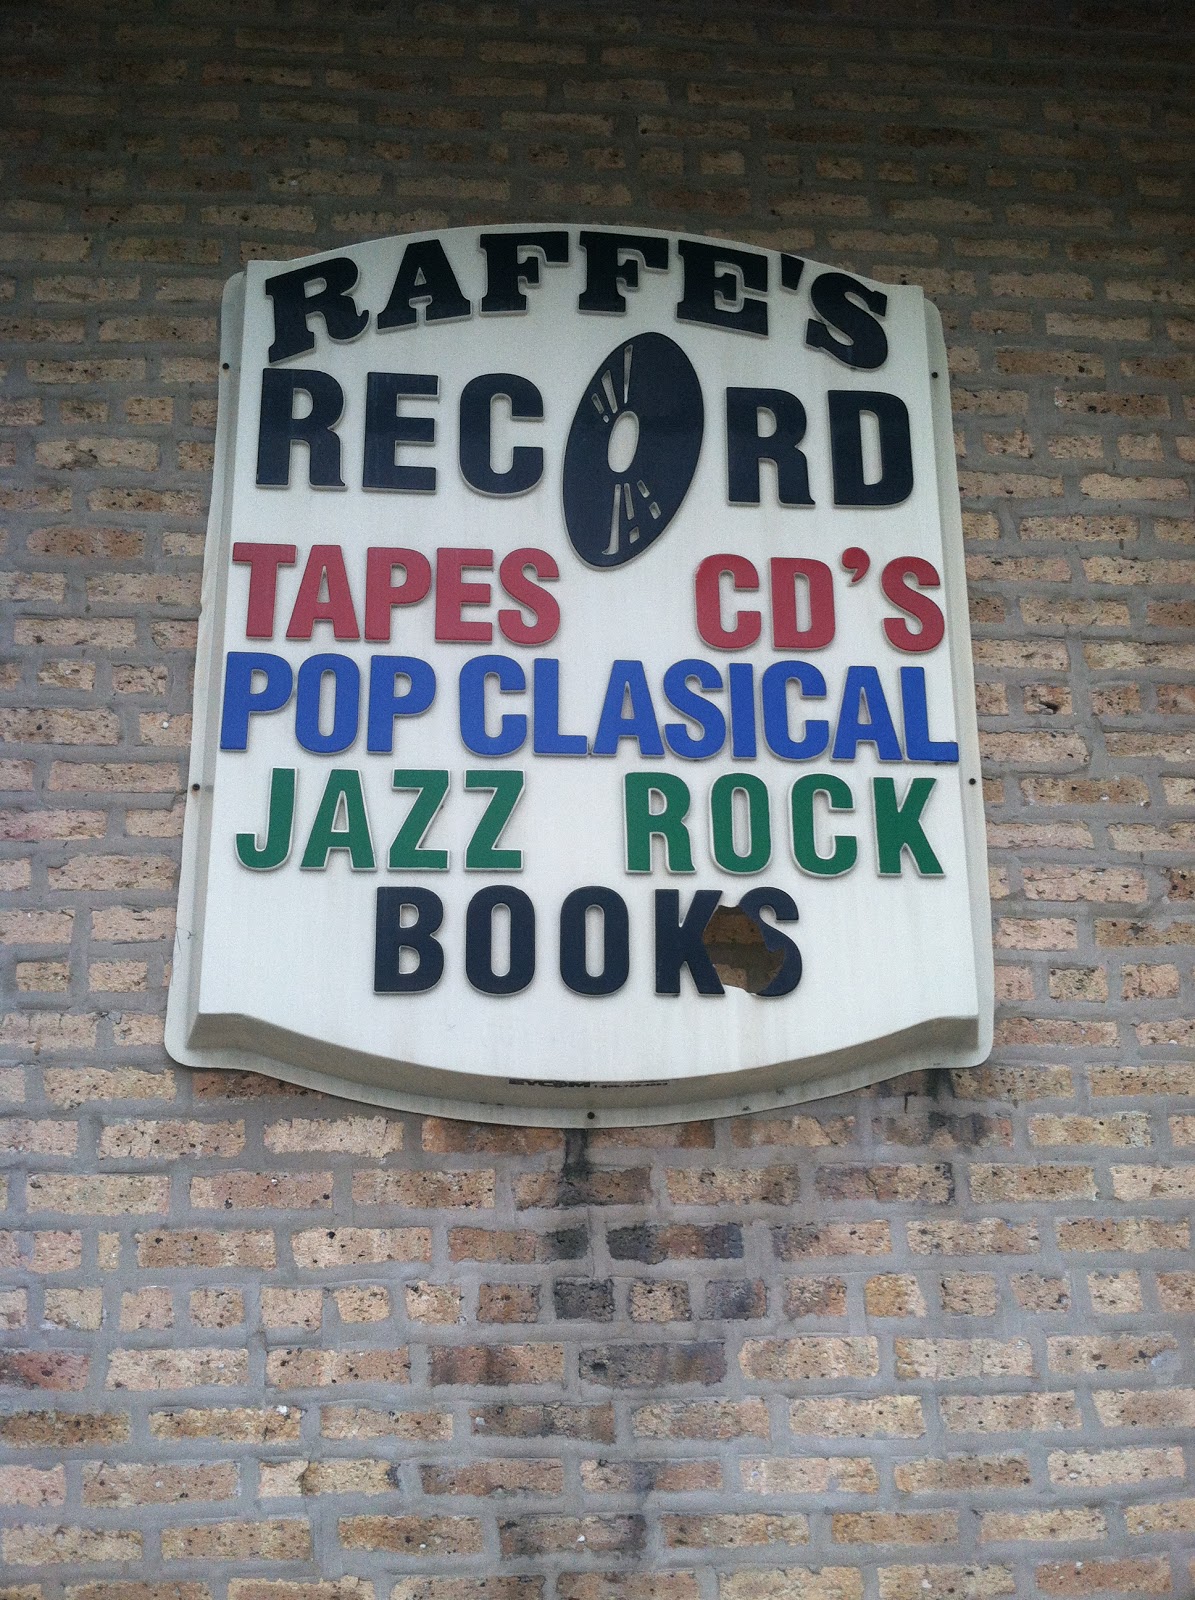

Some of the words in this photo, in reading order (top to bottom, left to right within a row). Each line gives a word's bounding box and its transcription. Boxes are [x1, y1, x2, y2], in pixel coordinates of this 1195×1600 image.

[265, 231, 889, 369] RAFFE'S
[233, 542, 560, 643] TAPES
[696, 547, 945, 652] CD'S
[220, 652, 437, 755] POP
[458, 657, 958, 762] CLASICAL
[235, 768, 524, 870] JAZZ
[624, 772, 945, 877] ROCK
[374, 885, 803, 997] BOOKS
